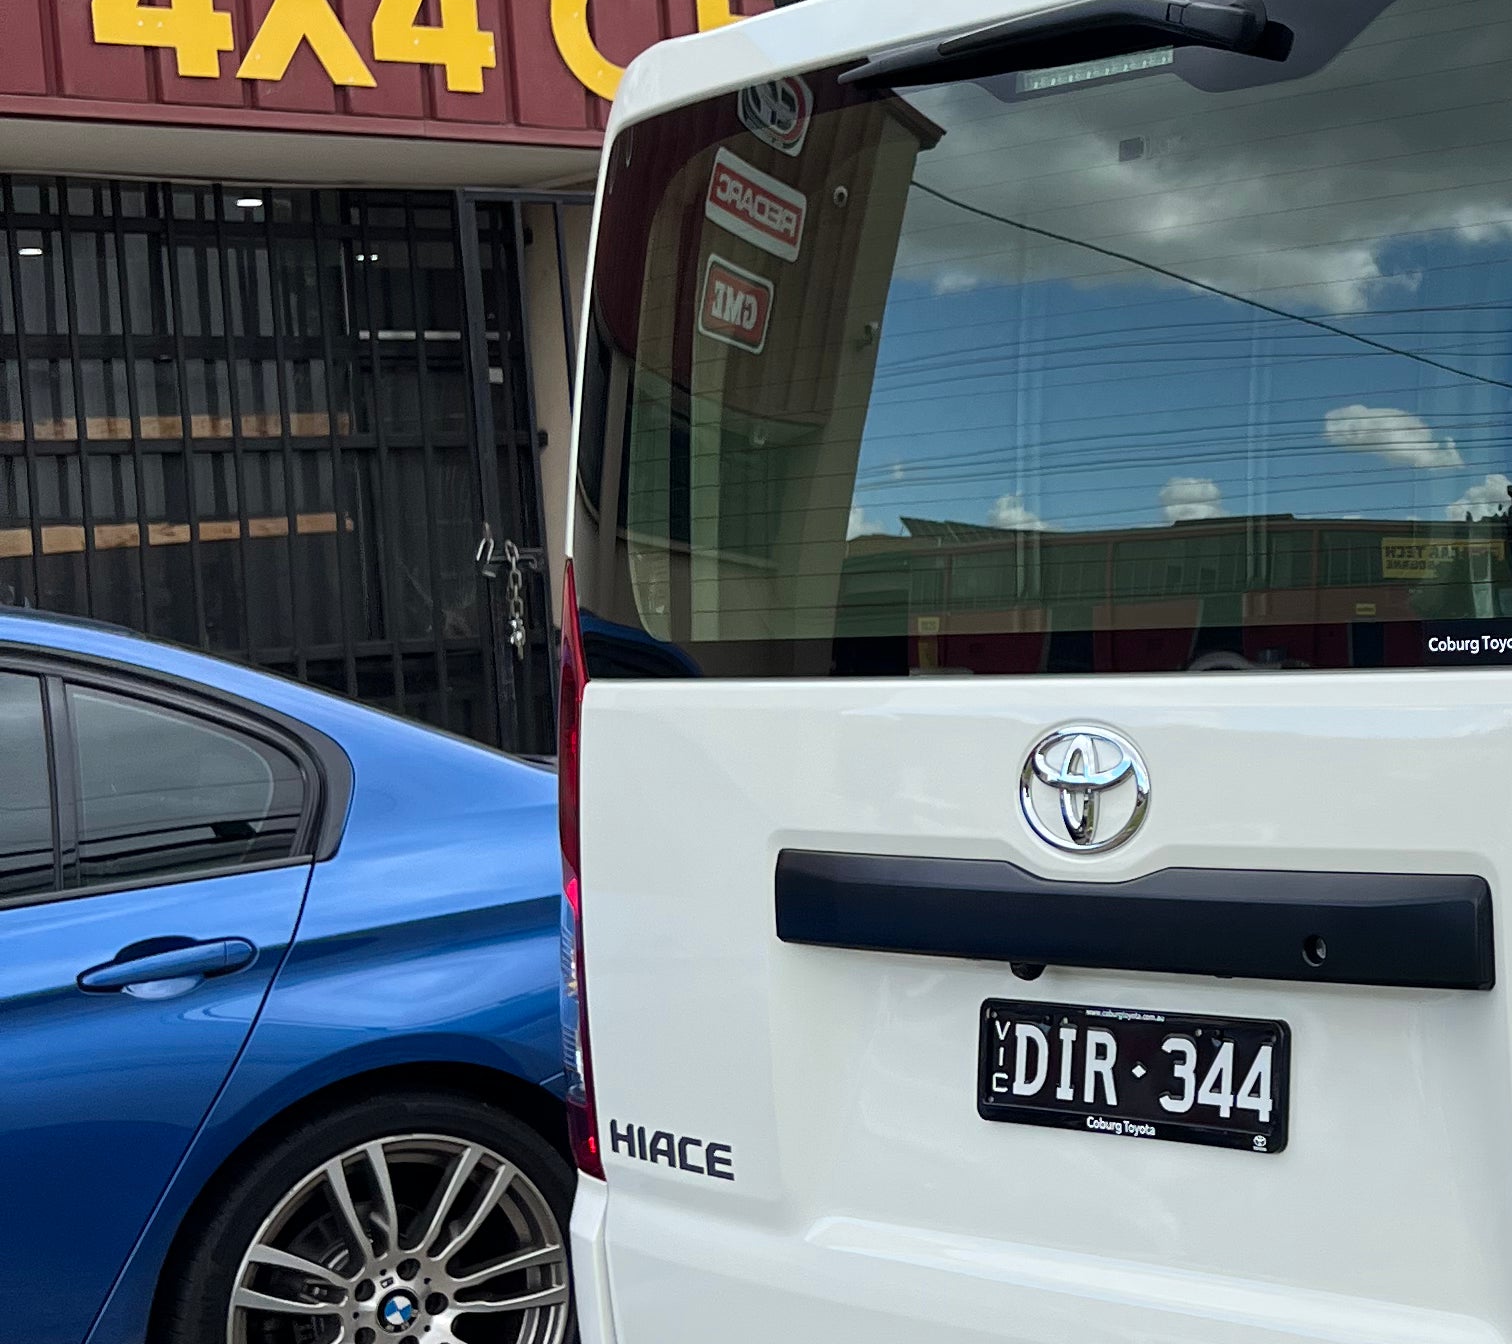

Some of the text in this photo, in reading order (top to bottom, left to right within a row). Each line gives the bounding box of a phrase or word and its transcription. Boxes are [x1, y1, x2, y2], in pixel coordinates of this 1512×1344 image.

[1428, 636, 1480, 654] Coburg
[991, 1020, 1011, 1093] VIC
[1012, 1023, 1273, 1123] DIR 344
[609, 1119, 735, 1181] HIACE
[1086, 1116, 1156, 1136] Coburg Toyota
